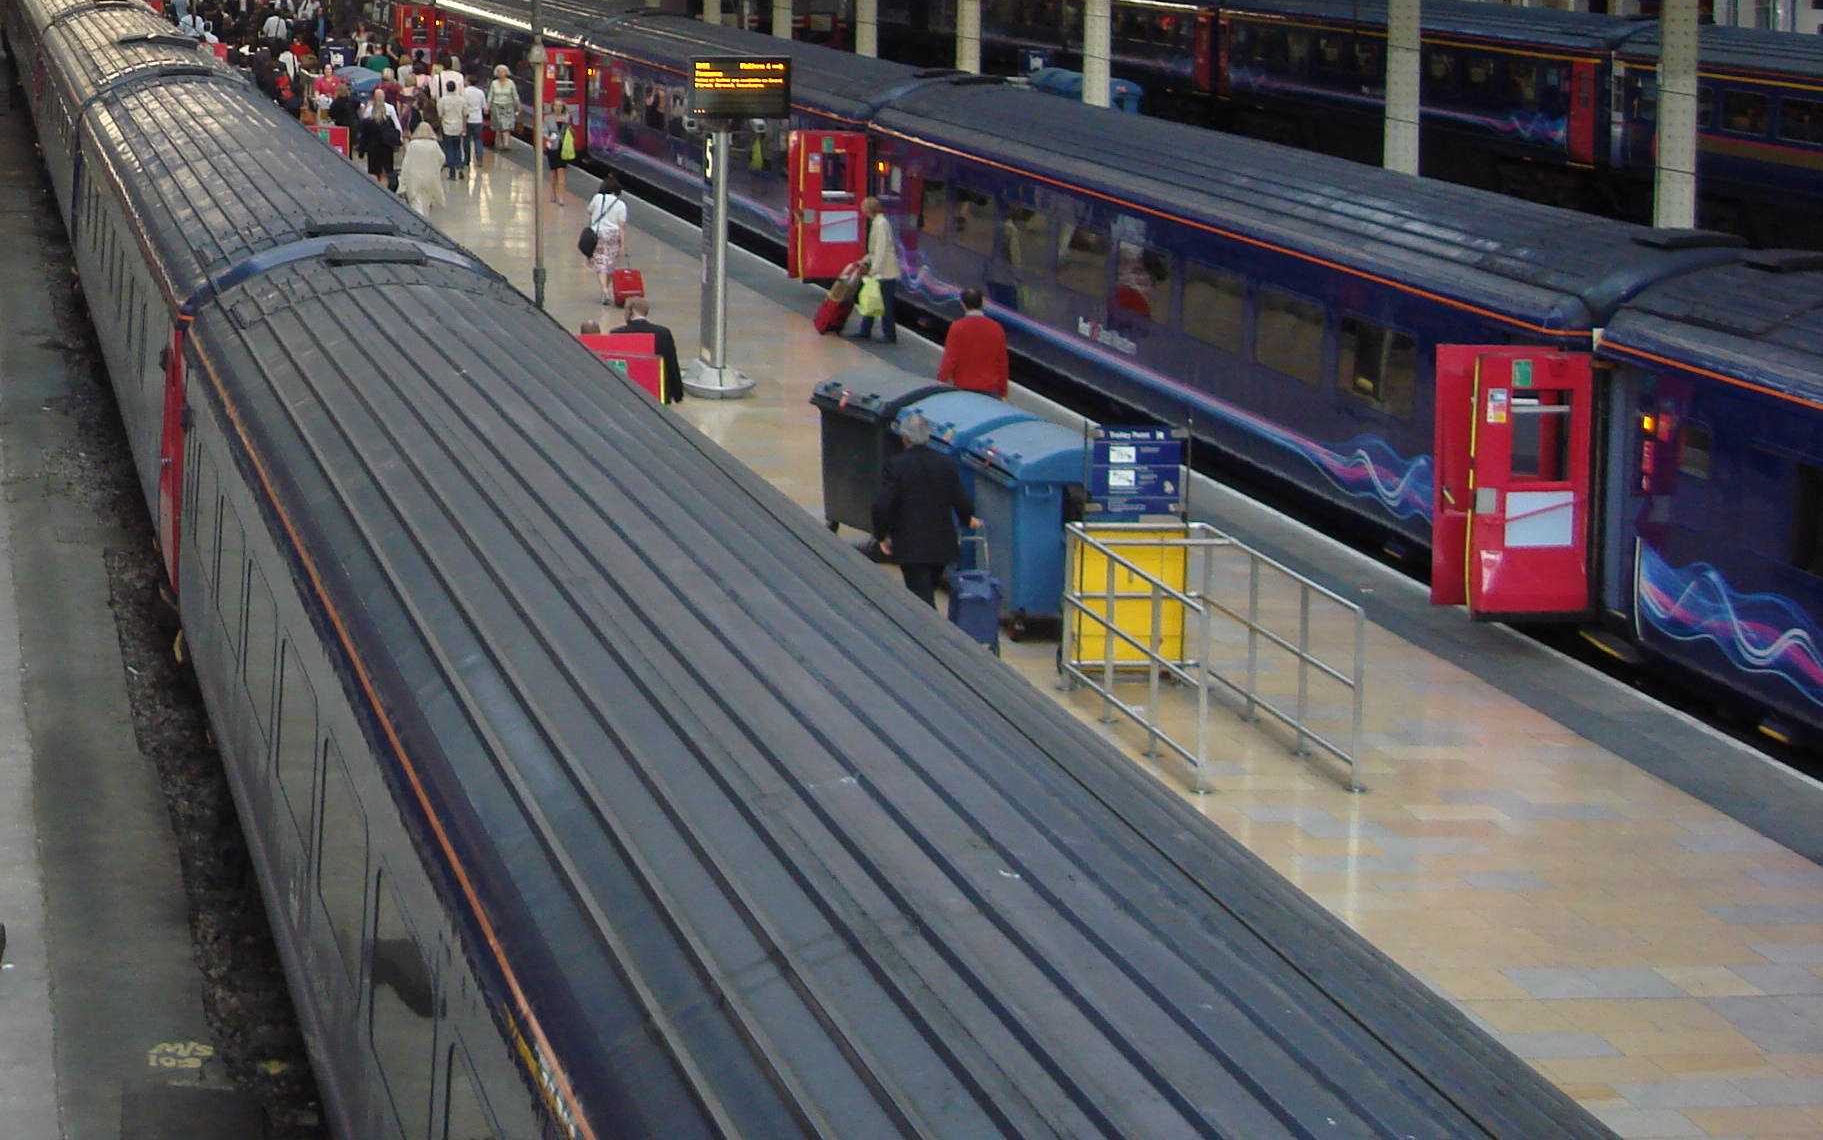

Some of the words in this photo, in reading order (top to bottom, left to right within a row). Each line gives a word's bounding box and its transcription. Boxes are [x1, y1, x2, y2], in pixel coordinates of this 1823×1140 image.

[706, 138, 713, 178] 5
[1109, 430, 1131, 440] Trolley
[1131, 431, 1151, 439] Point
